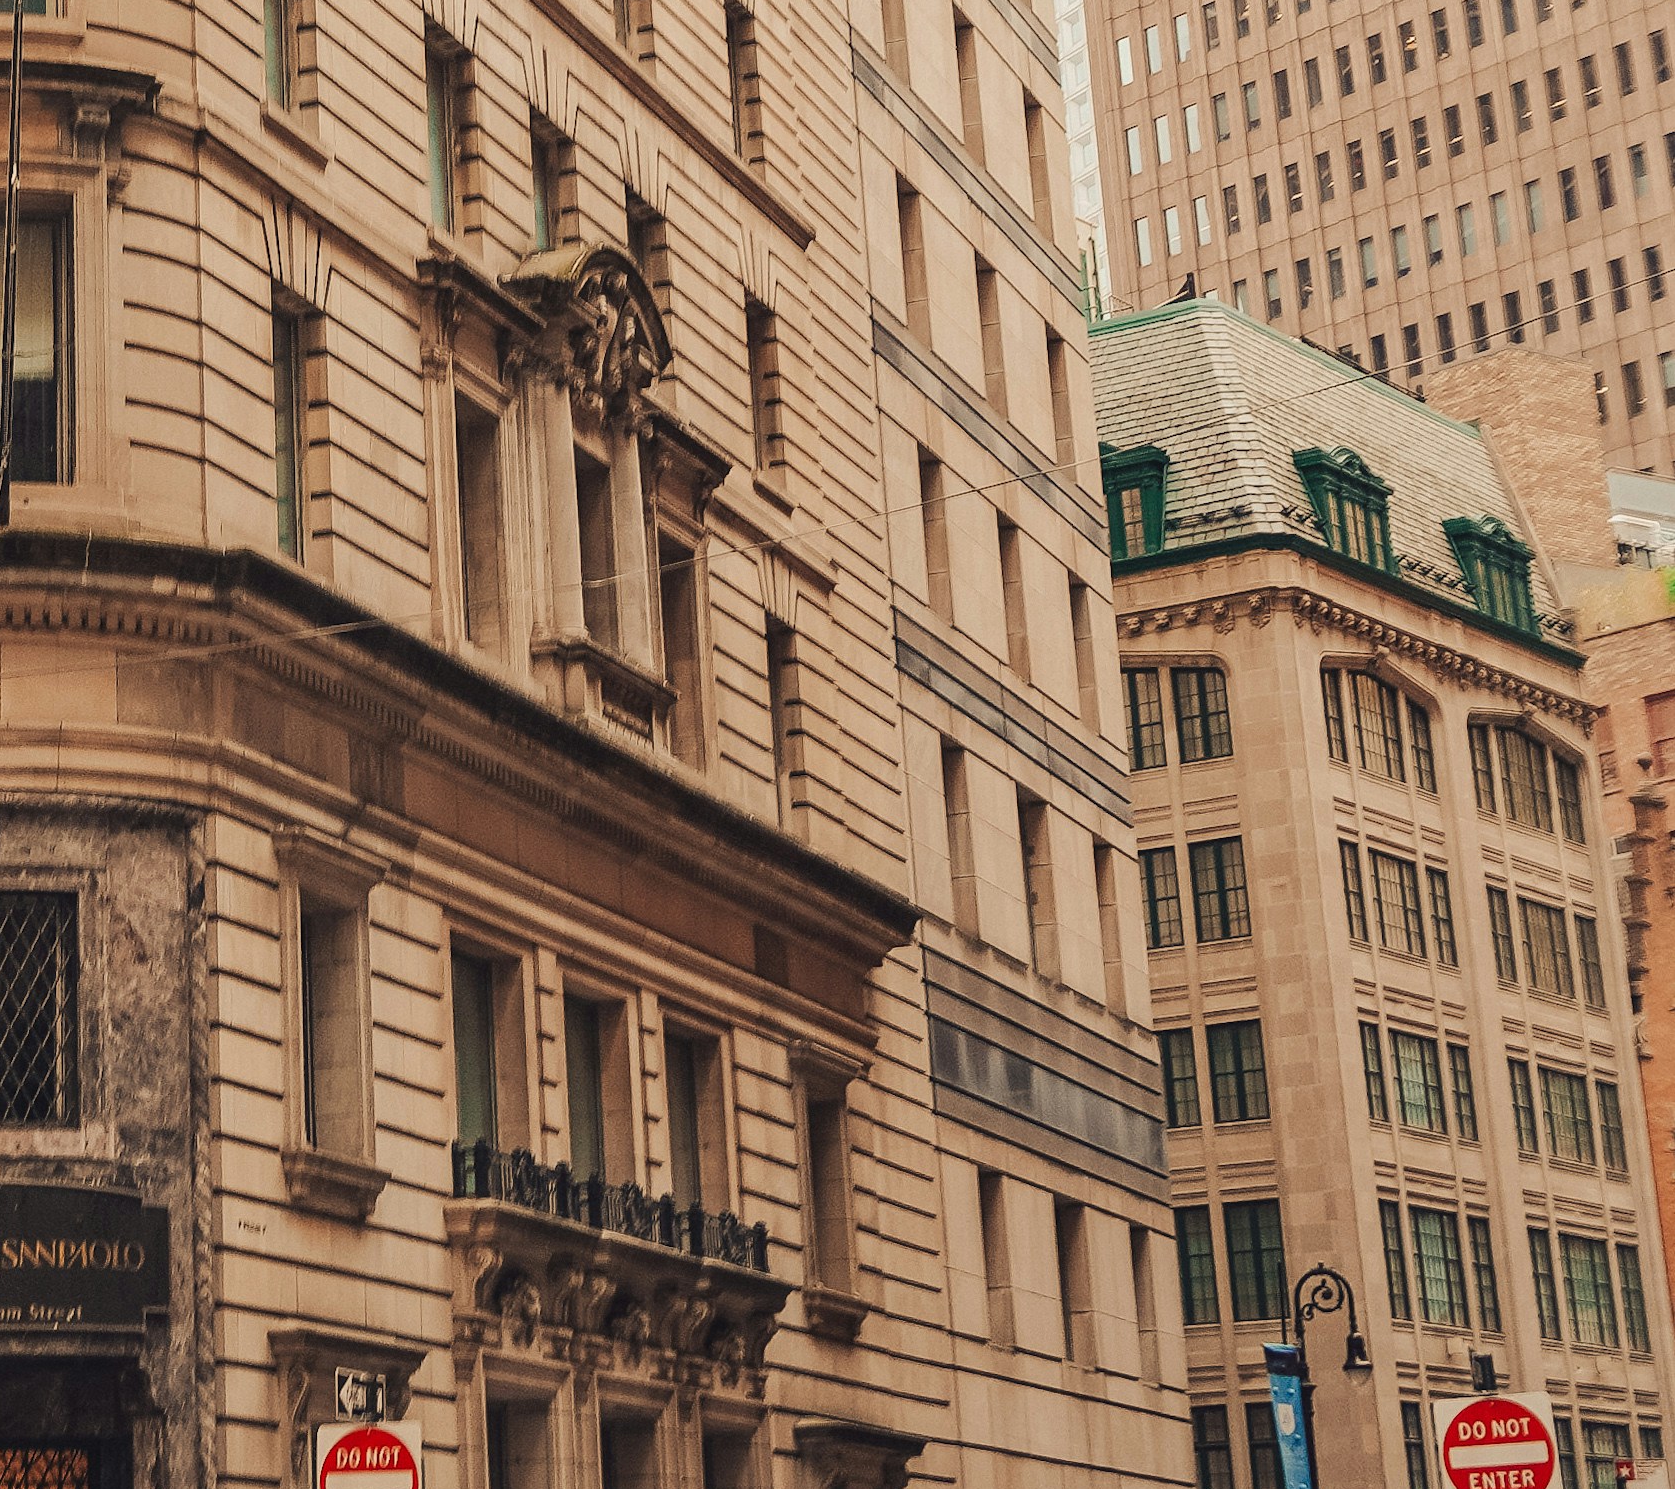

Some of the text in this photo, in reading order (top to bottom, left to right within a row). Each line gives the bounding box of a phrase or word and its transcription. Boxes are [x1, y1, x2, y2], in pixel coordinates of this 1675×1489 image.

[29, 1302, 83, 1322] Street
[1458, 1417, 1531, 1441] DO NOT
[336, 1445, 401, 1469] DO NOT
